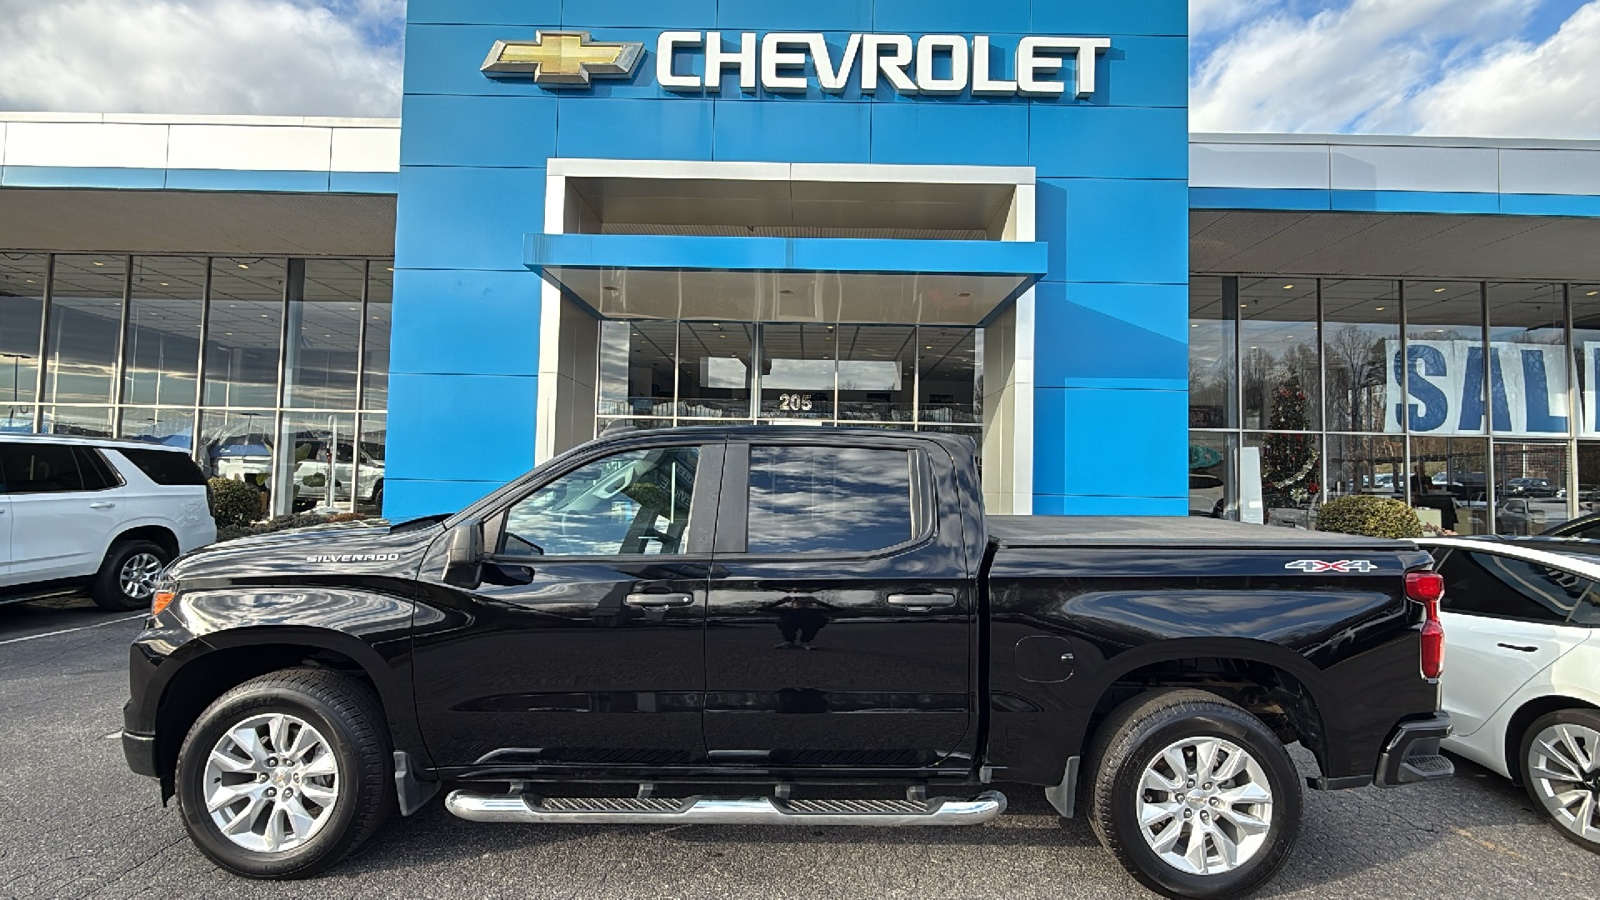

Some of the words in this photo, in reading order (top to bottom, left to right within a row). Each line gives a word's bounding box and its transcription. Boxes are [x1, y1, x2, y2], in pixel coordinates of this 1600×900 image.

[656, 30, 1111, 99] CHEVROLET
[779, 393, 813, 411] 205
[1393, 344, 1600, 433] SAL
[306, 553, 400, 563] SILVERADO
